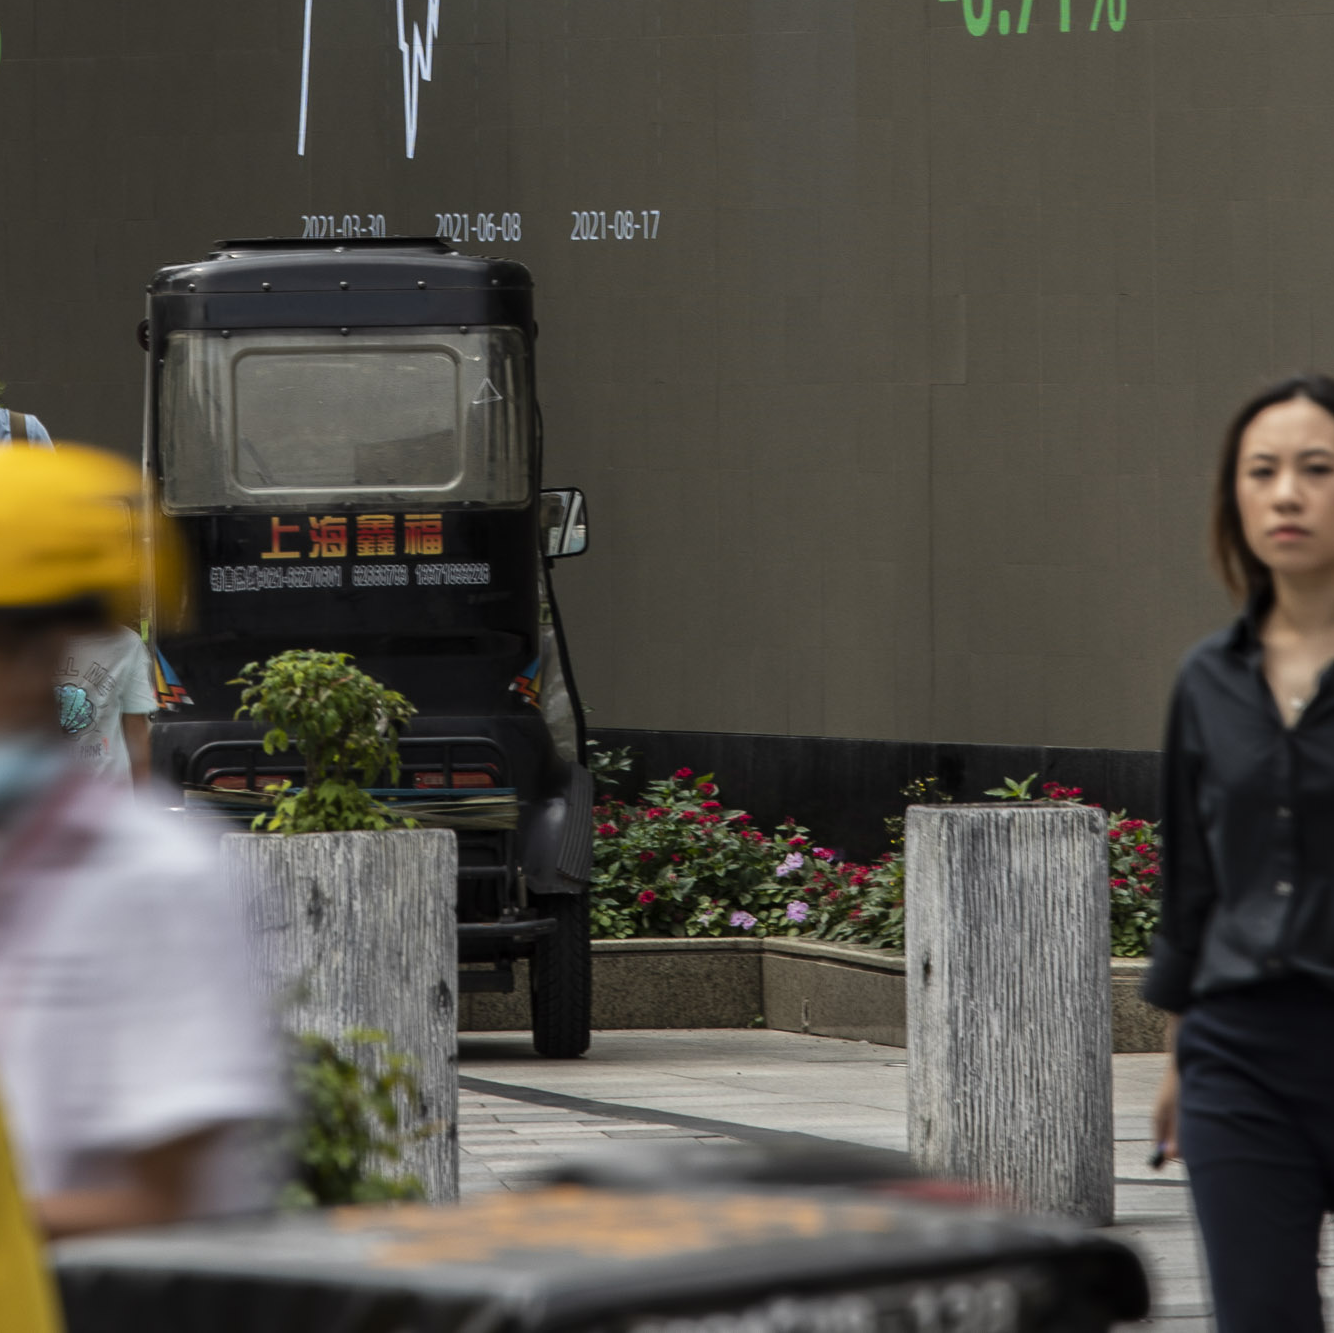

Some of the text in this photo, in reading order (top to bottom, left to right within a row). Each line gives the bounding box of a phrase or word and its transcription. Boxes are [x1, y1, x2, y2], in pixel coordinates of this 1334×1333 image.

[301, 209, 661, 243] 2021-03-30 2021-06-08 2021-08-17
[260, 513, 444, 559] 上海鑫福
